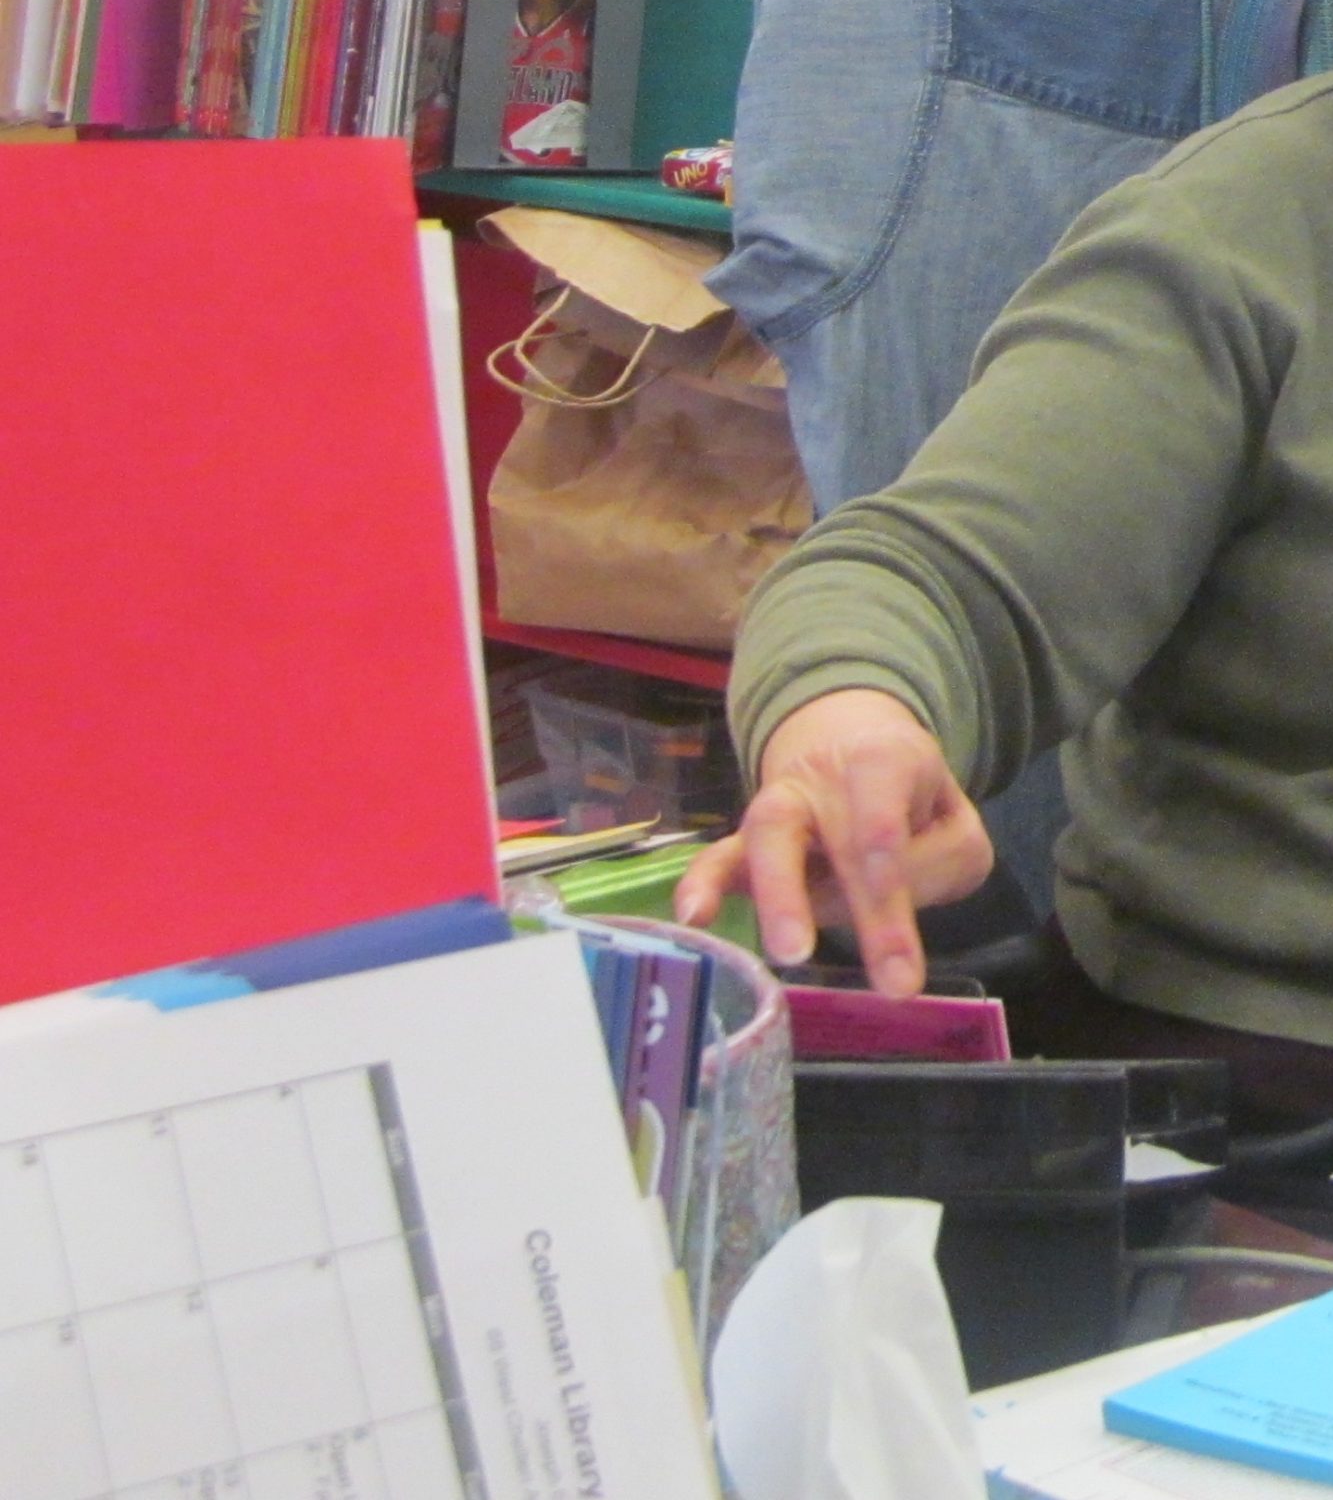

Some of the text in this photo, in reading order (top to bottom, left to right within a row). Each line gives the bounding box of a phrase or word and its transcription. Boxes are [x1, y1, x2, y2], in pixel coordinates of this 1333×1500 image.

[674, 162, 709, 188] UNO
[523, 1228, 607, 1499] Coleman Library
